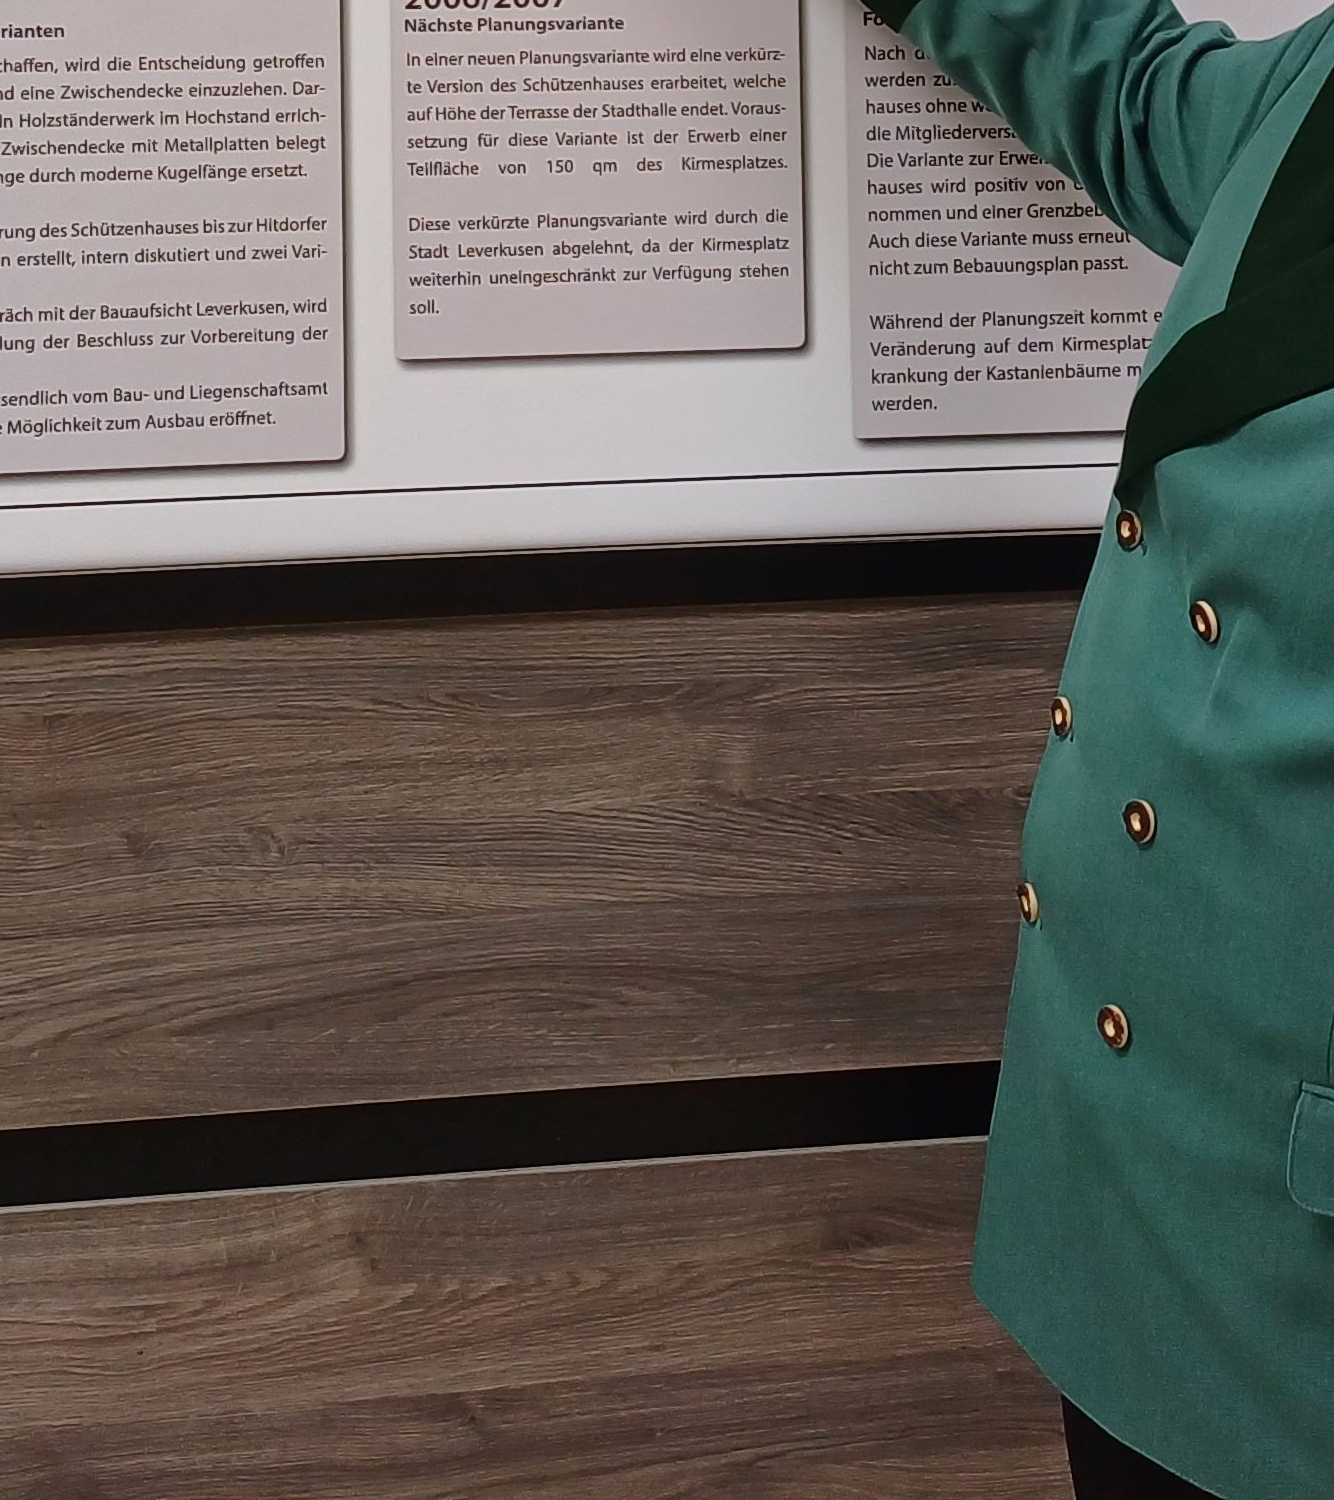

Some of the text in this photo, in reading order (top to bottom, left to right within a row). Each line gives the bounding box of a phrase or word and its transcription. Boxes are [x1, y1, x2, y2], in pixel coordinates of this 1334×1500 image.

[404, 15, 625, 34] Nächste Planungsvariante
[64, 56, 101, 72] wird
[106, 55, 132, 71] die
[138, 54, 246, 72] Entscheidung
[252, 52, 325, 72] getroffen
[20, 85, 56, 100] eine
[60, 82, 184, 99] Zwischendecke
[188, 81, 288, 97] einzuziehen.
[292, 81, 326, 95] Dar-
[406, 127, 788, 151] setzung für diese Variante ist der Erwerb einer
[406, 154, 788, 176] Teilfläche von 150 qm des Kirmesplatzes.
[408, 235, 790, 259] Stadt Leverkusen abgelehnt, da der Kirmesplatz
[867, 230, 1131, 248] Auch diese Variante muss erneut
[408, 262, 790, 287] weiterhin uneingeschränkt zur Verfügung stehen
[869, 255, 1129, 276] nicht zum Bebauungsplan passt.
[409, 298, 440, 314] soll.
[868, 308, 1148, 329] Während der Planungszeit kommt
[869, 336, 1054, 358] Veränderung auf dem
[871, 362, 1122, 386] krankung der Kastanienbäume
[871, 394, 938, 411] werden.
